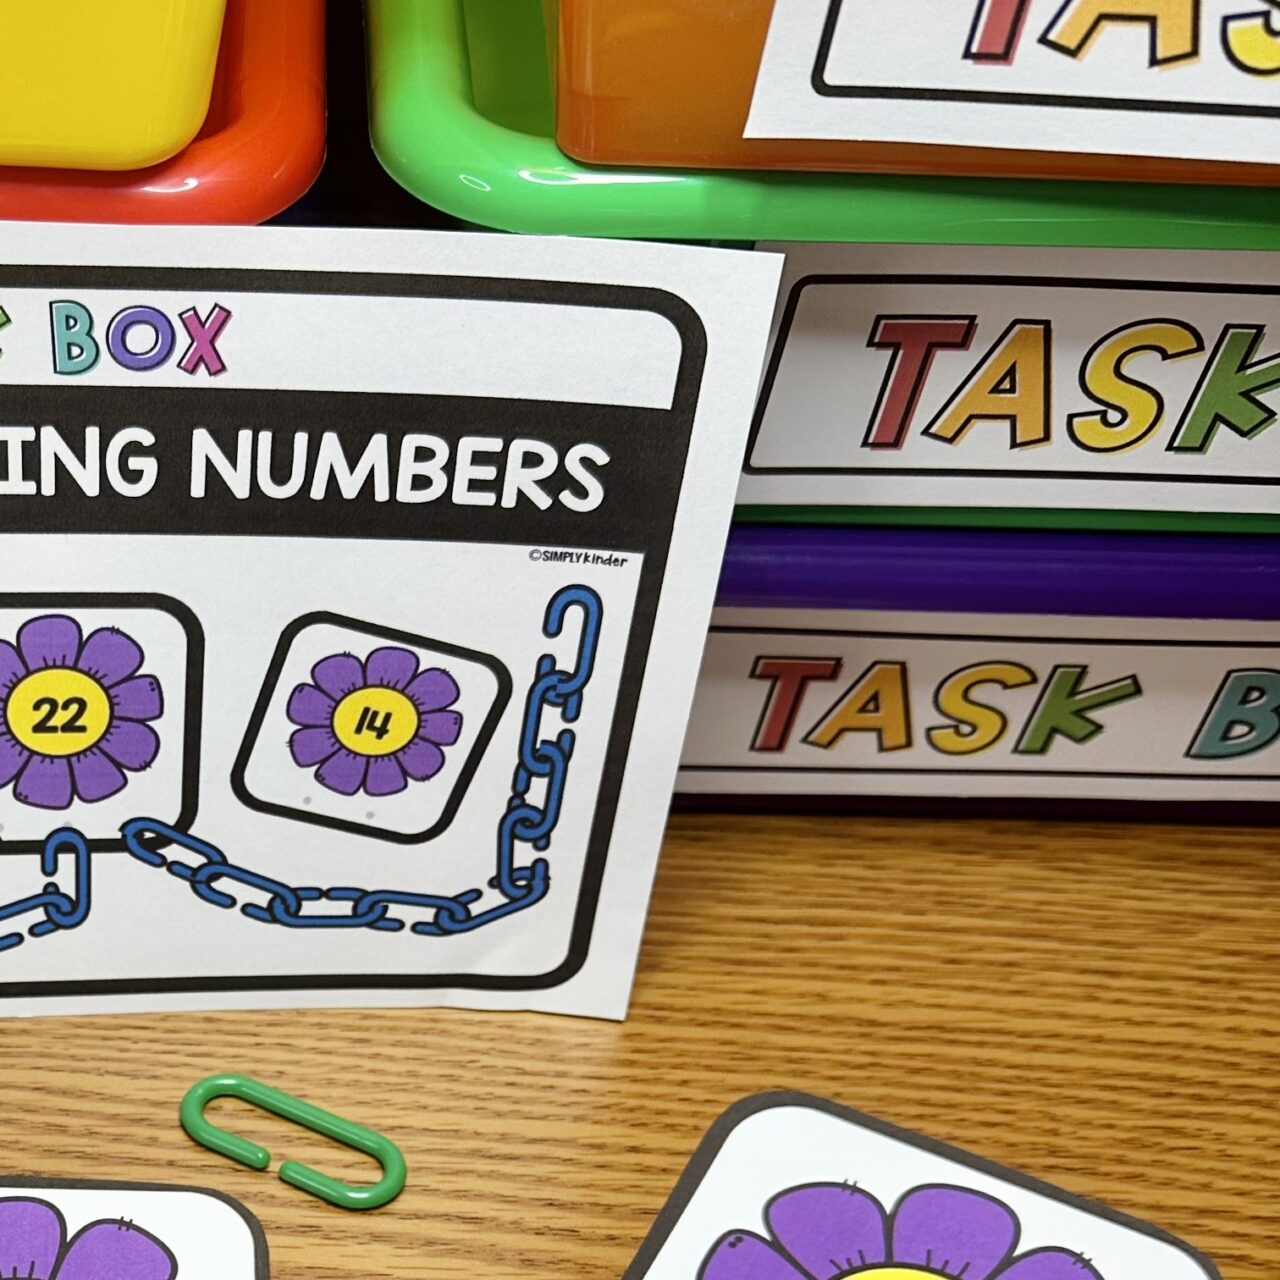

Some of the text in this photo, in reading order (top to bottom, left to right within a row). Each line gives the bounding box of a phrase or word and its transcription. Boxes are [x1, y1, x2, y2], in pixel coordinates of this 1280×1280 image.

[49, 300, 232, 377] BOX
[860, 314, 1280, 455] TASK
[190, 428, 611, 512] NUMBERS
[30, 697, 89, 734] 22
[354, 706, 392, 739] 14
[749, 656, 1142, 756] TASK
